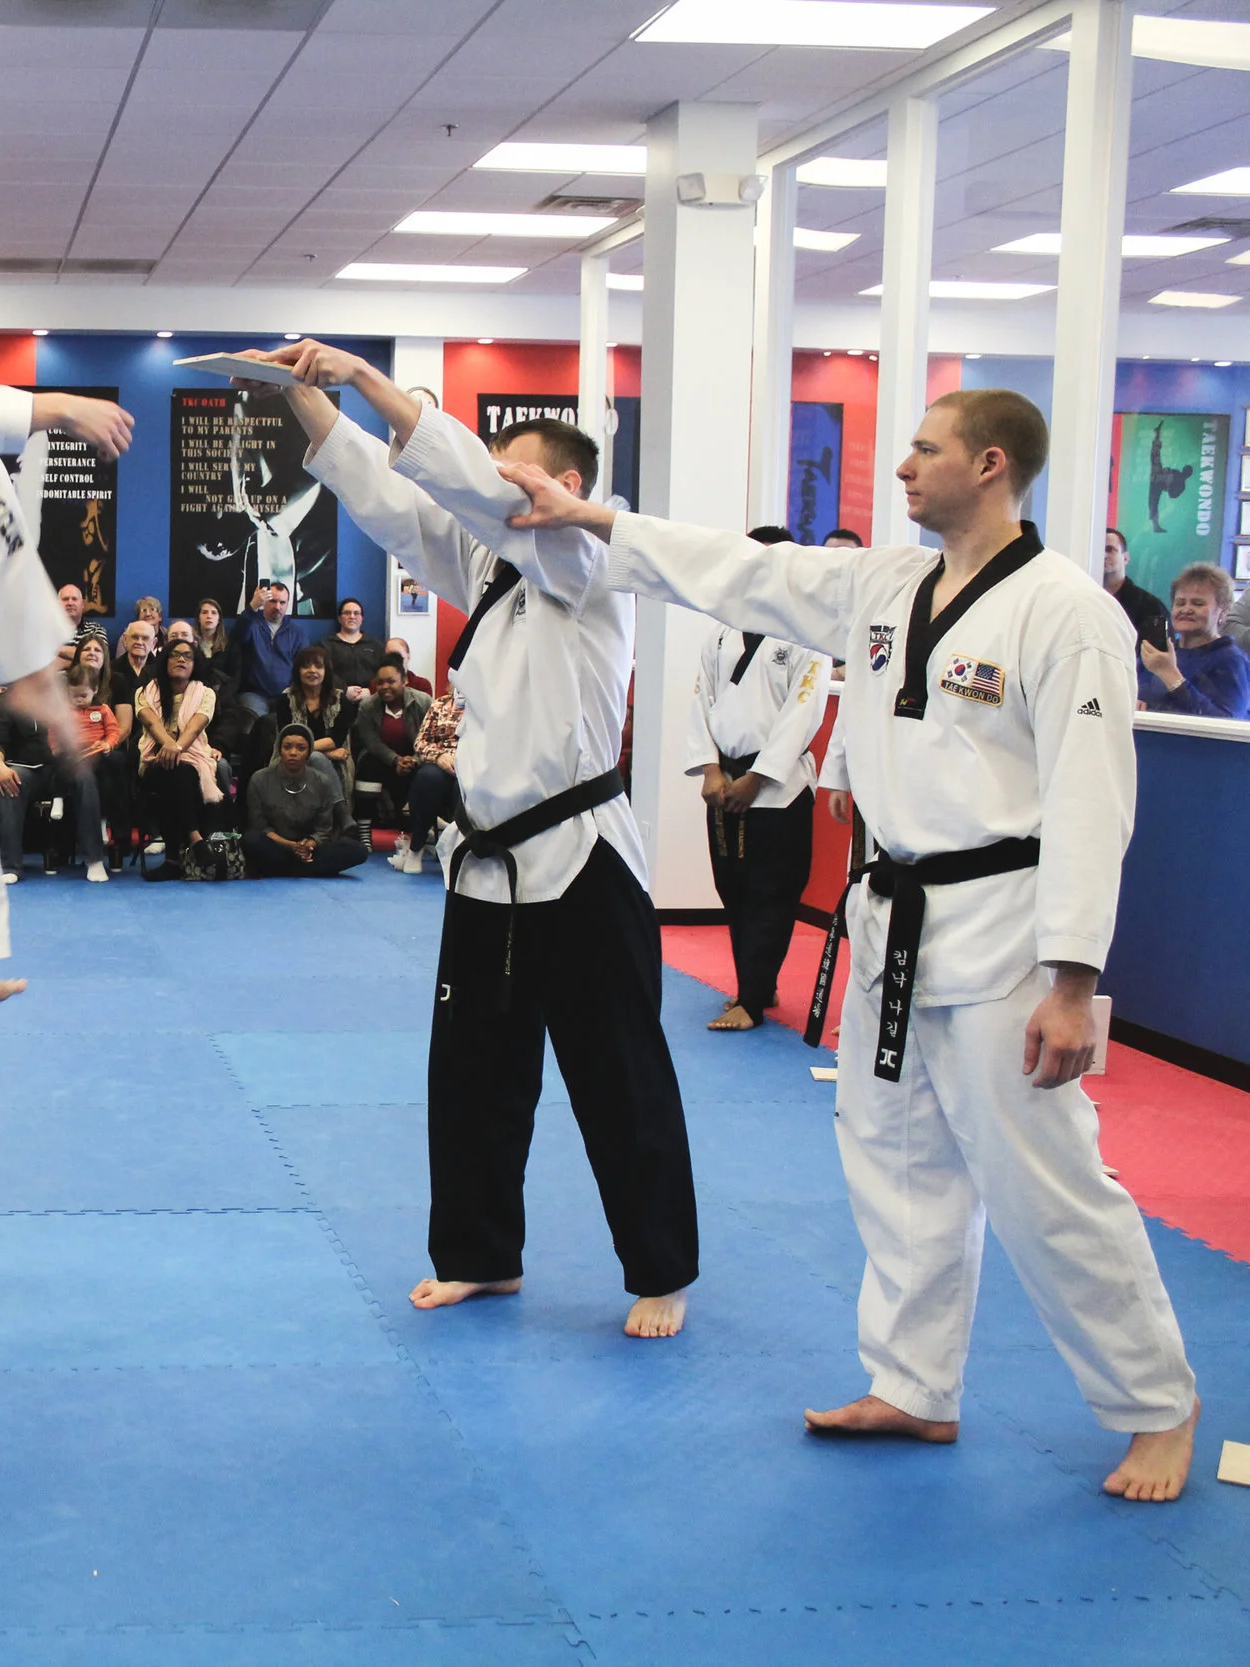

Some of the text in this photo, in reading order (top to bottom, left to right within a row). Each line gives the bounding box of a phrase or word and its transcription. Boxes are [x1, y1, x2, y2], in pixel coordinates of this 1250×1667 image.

[189, 416, 209, 425] WILL
[213, 417, 224, 425] BE
[228, 417, 283, 427] RESPECTFUL
[182, 426, 253, 435] TO MY PARENTS
[48, 441, 87, 451] INTEGRITY
[189, 440, 209, 448] WILL
[213, 440, 224, 448] BE
[237, 440, 263, 449] LIGHT
[266, 441, 276, 449] IN
[182, 449, 244, 458] THIS SOCIEY
[188, 462, 209, 470] WILL
[213, 463, 240, 471] SERE
[244, 463, 255, 471] MY
[60, 474, 94, 483] CONTROL
[181, 472, 223, 480] COUNTRY
[1196, 419, 1219, 536] TAEKWONDO
[188, 485, 208, 493] WILL
[87, 490, 112, 499] SPIRIT
[206, 495, 223, 503] NOT
[251, 495, 262, 503] UP
[266, 495, 278, 503] ON
[181, 504, 207, 512] FIGHT
[987, 694, 999, 703] DO
